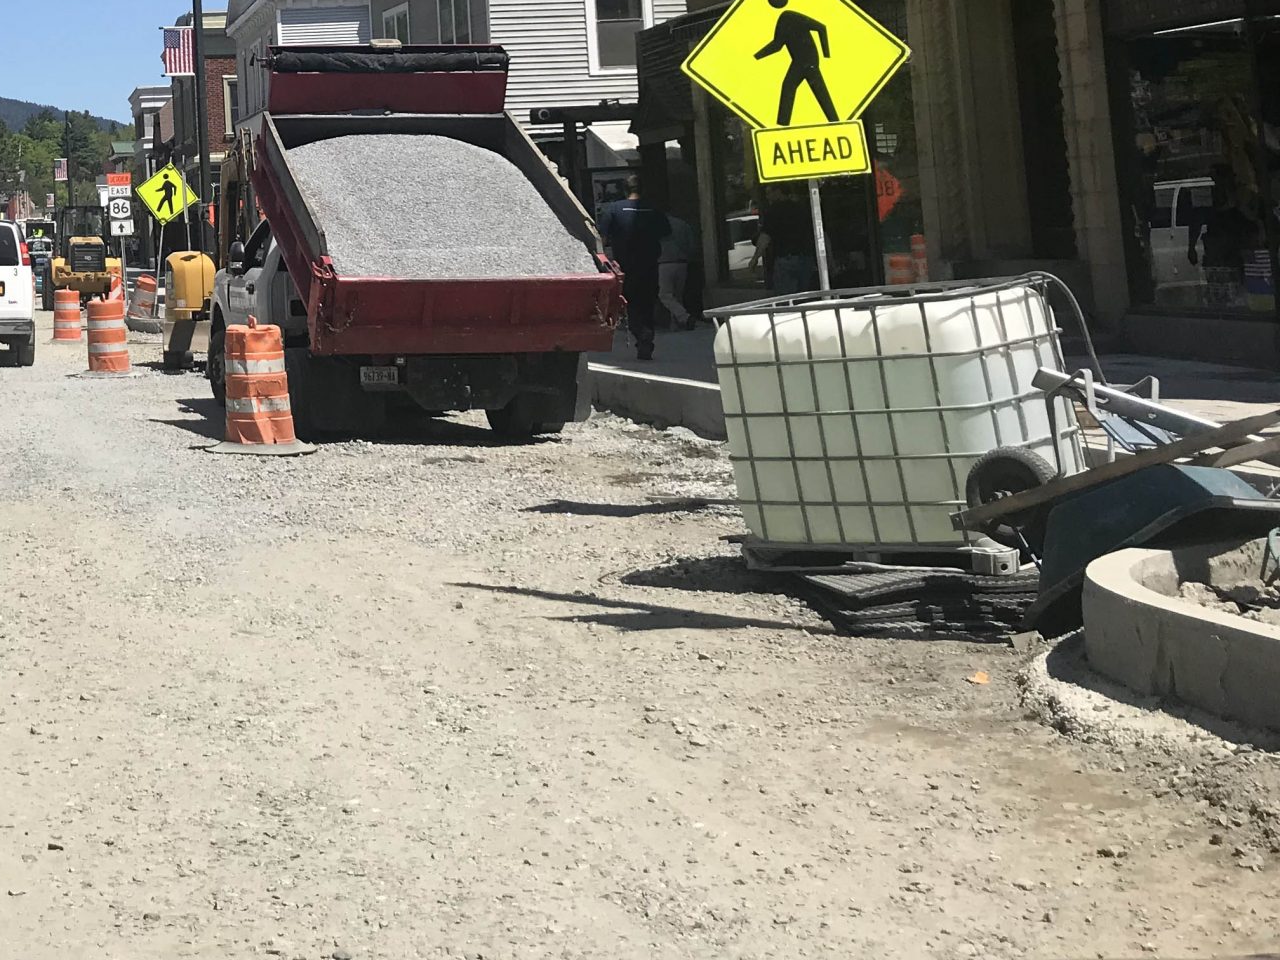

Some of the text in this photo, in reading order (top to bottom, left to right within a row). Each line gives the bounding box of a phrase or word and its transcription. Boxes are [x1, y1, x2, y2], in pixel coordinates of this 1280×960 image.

[772, 136, 852, 166] AHEAD
[111, 187, 128, 195] EAST
[113, 202, 129, 214] 86
[14, 268, 18, 276] 3
